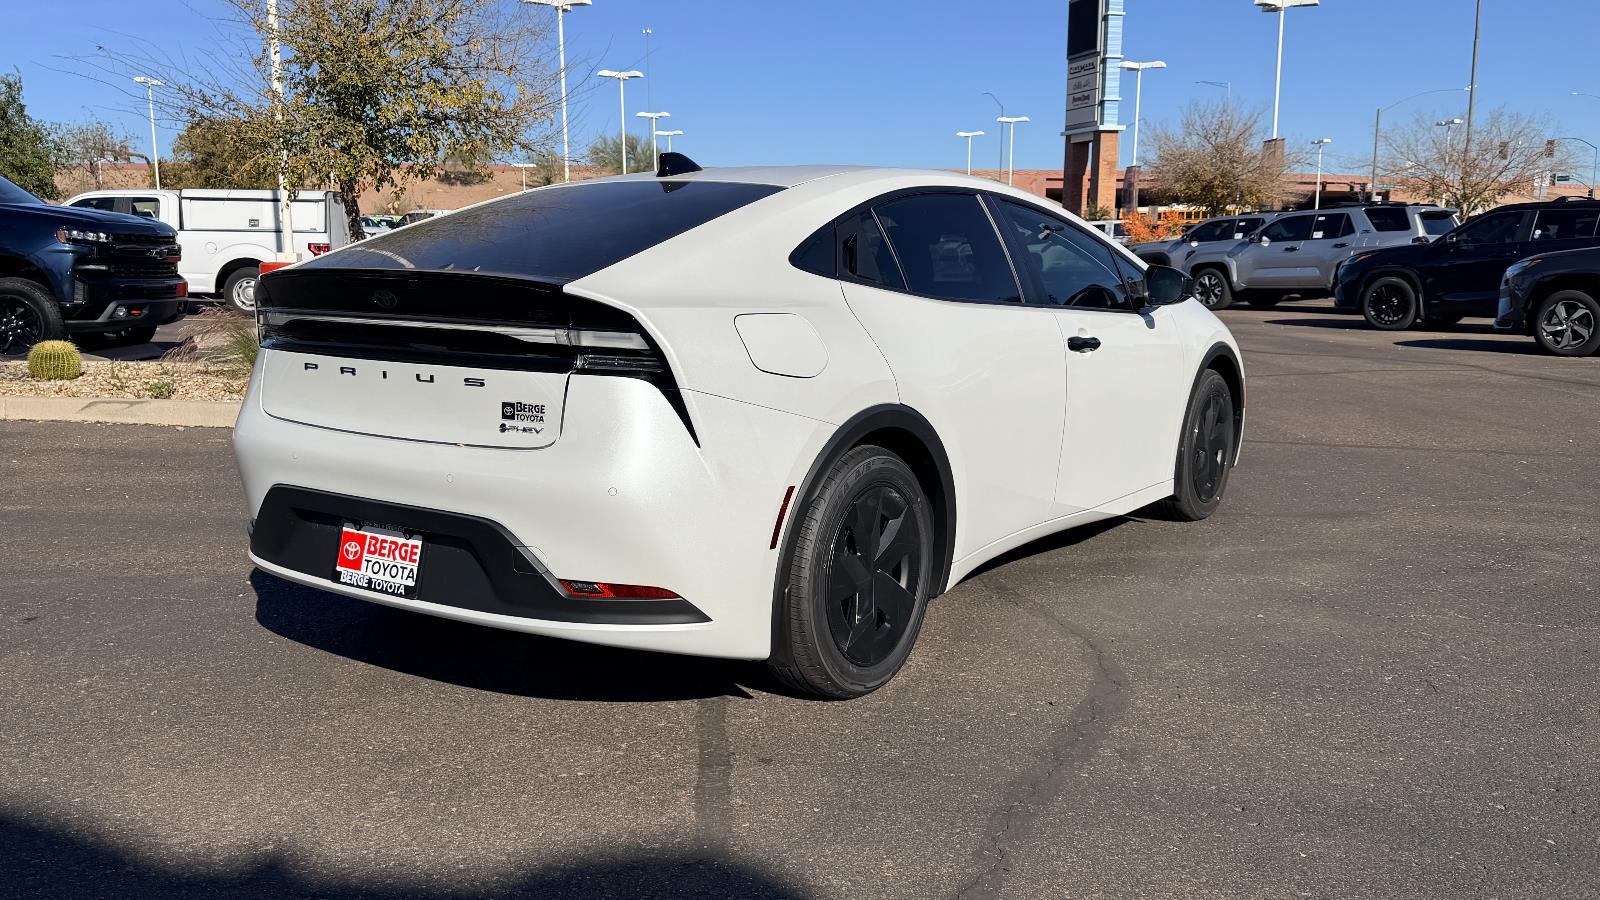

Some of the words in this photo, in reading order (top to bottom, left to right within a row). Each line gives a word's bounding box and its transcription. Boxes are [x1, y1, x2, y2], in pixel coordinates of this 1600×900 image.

[304, 362, 486, 388] PRIUS
[515, 401, 546, 415] BERGE
[516, 413, 545, 423] TOYOTA
[366, 535, 420, 564] BERGE
[340, 570, 370, 588] BERGE
[371, 579, 405, 596] TOYOTA
[364, 559, 415, 583] TOYOTA
